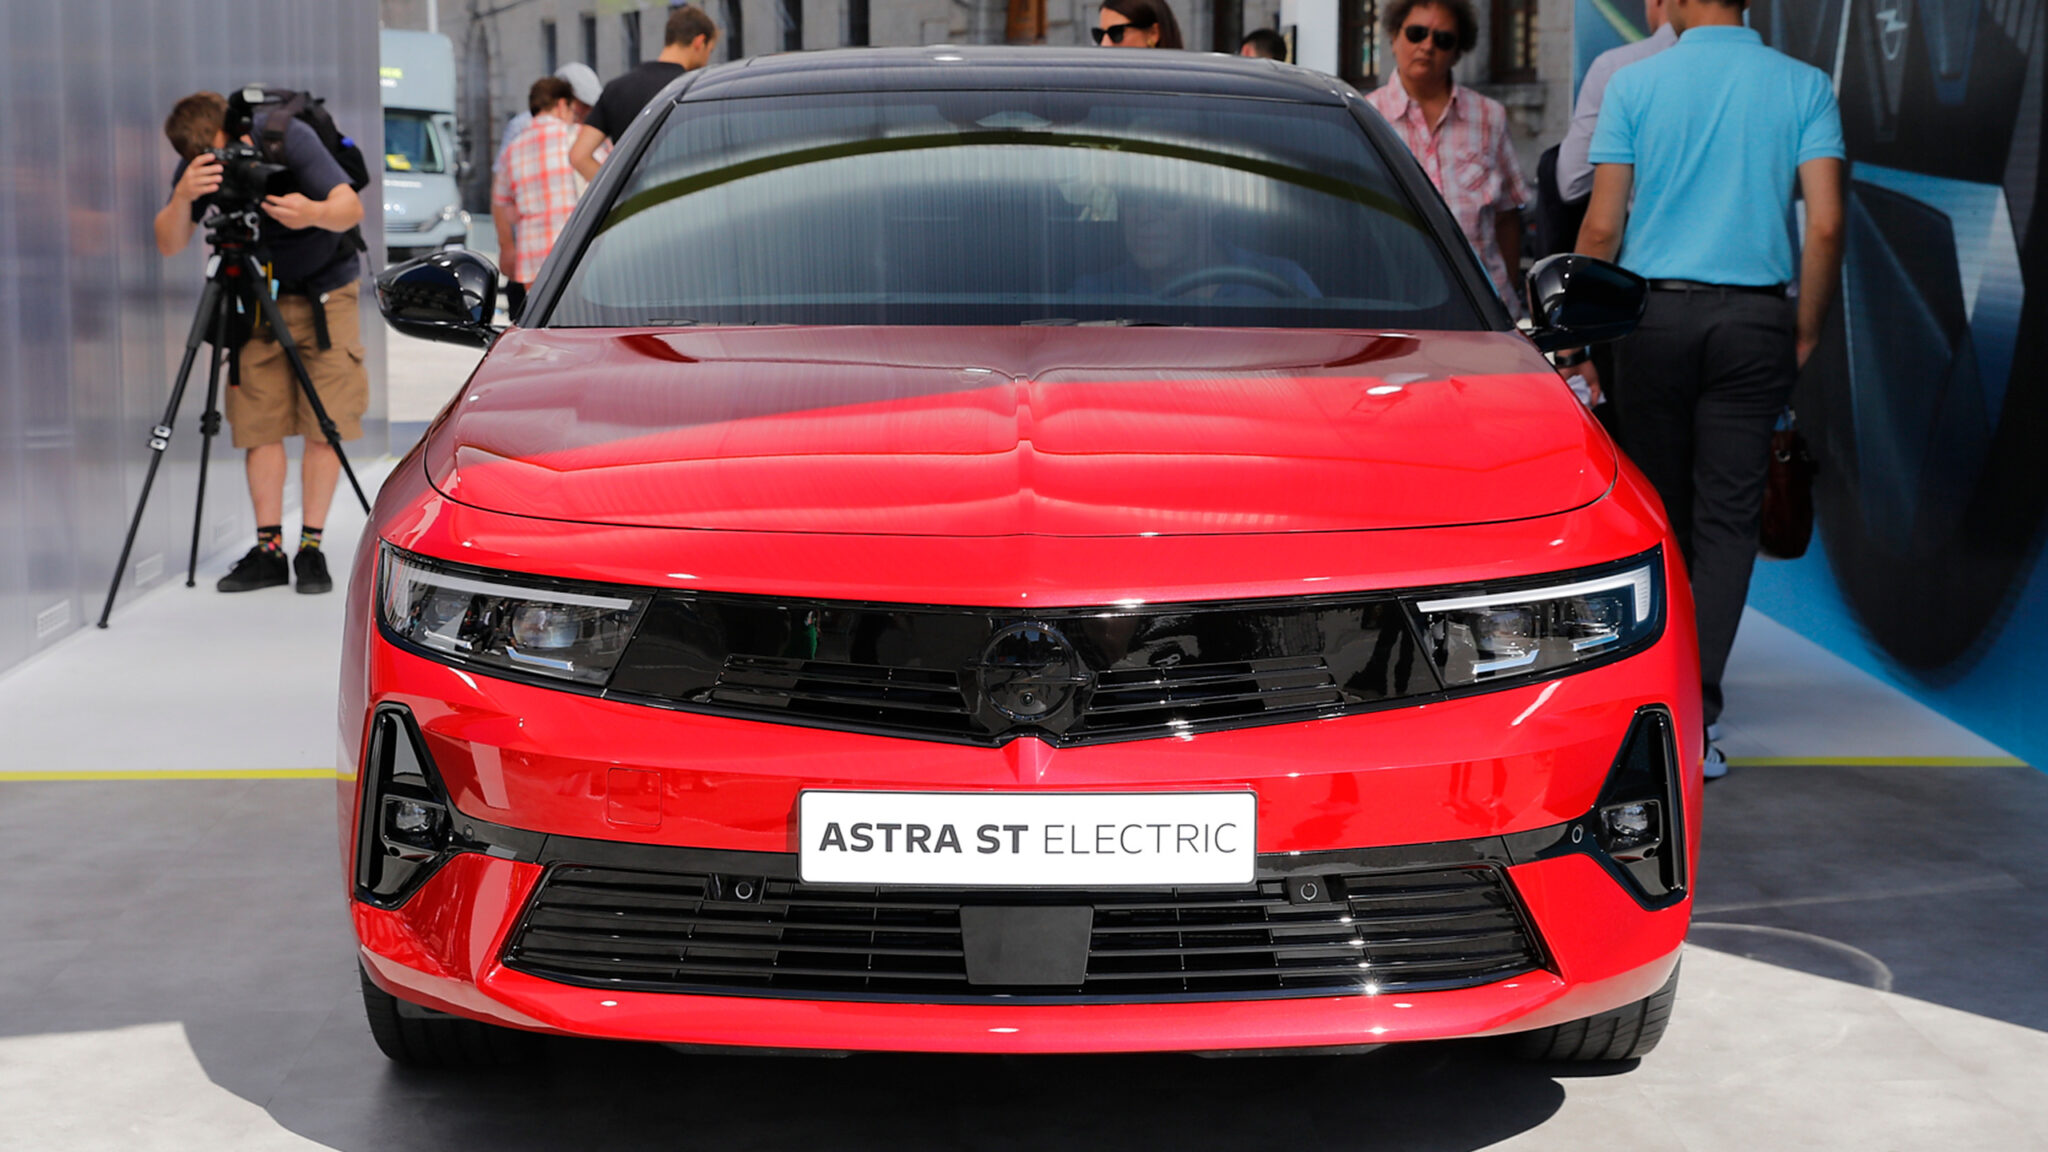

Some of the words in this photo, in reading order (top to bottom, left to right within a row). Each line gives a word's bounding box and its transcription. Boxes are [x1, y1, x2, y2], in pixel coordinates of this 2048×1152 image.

[819, 822, 962, 853] ASTRA
[976, 823, 1028, 854] ST
[1044, 823, 1237, 854] ELECTRIC
